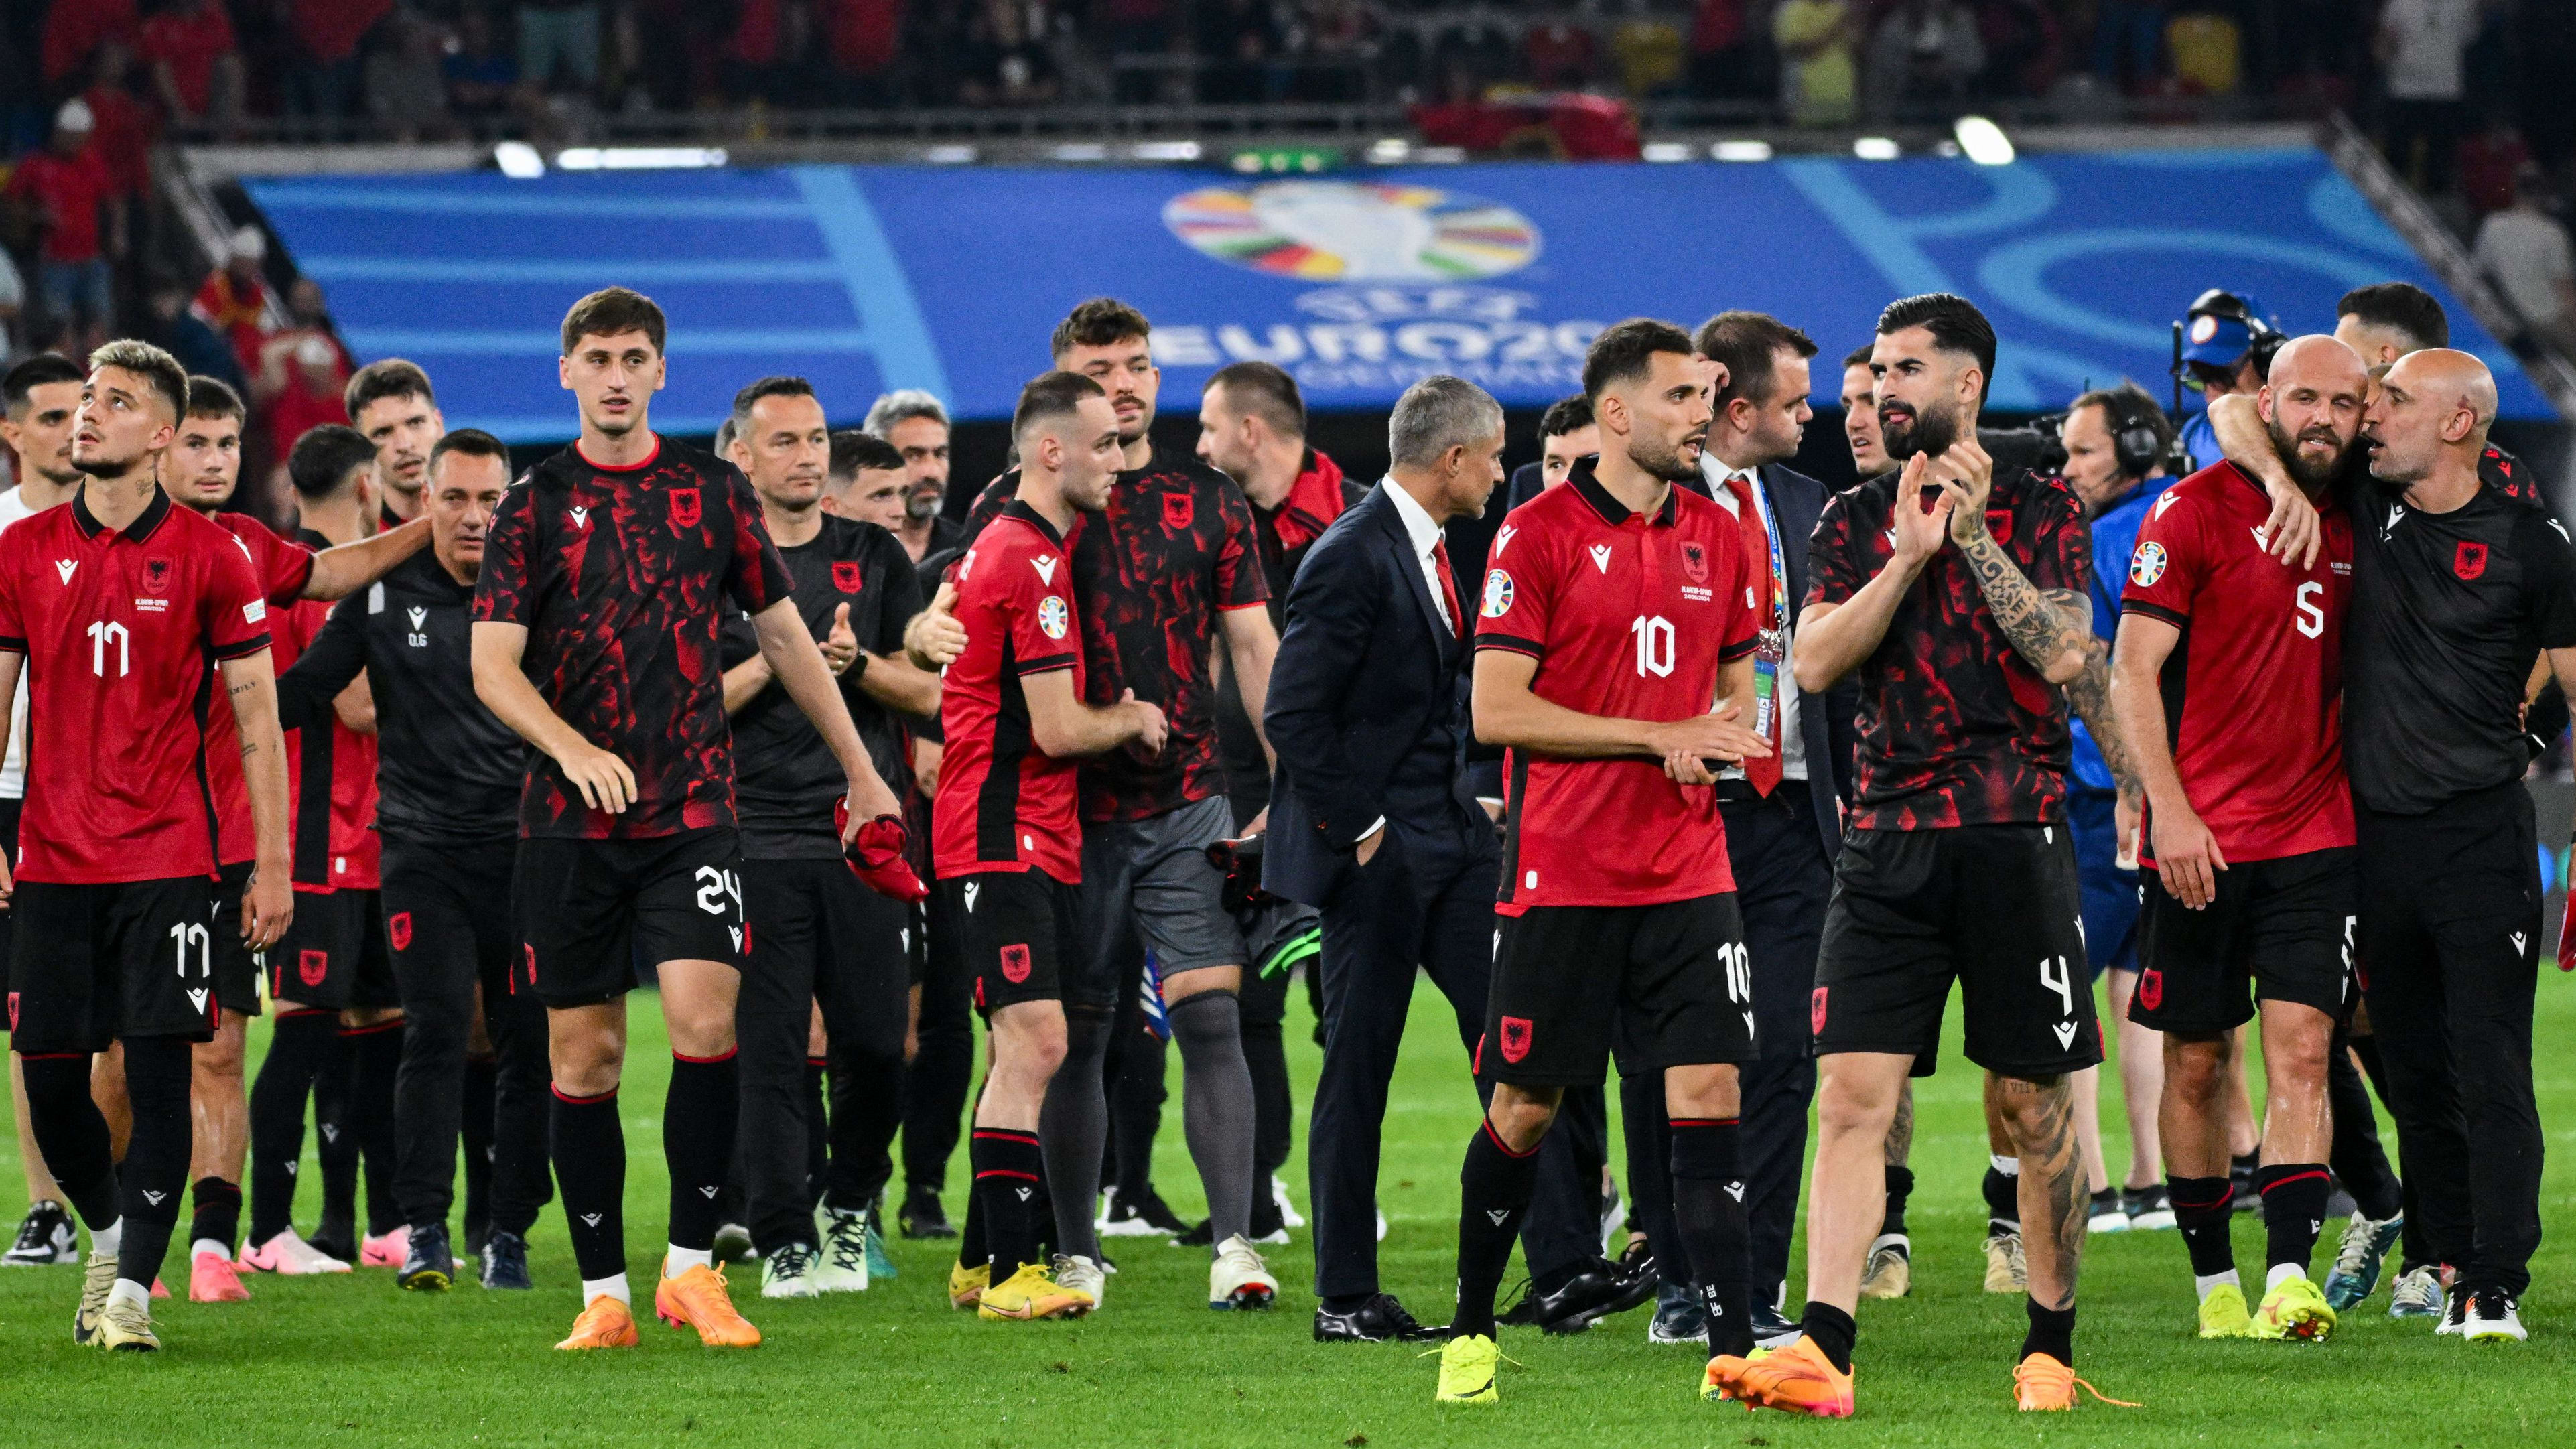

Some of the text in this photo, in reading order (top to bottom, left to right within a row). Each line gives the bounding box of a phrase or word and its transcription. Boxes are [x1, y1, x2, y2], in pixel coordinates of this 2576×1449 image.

[2296, 581, 2324, 640] 5
[87, 620, 129, 677] 17
[1631, 615, 1676, 678] 10
[695, 865, 744, 923] 24
[170, 922, 210, 978] 17
[1717, 941, 1751, 1004] 10
[2040, 955, 2073, 1017] 4
